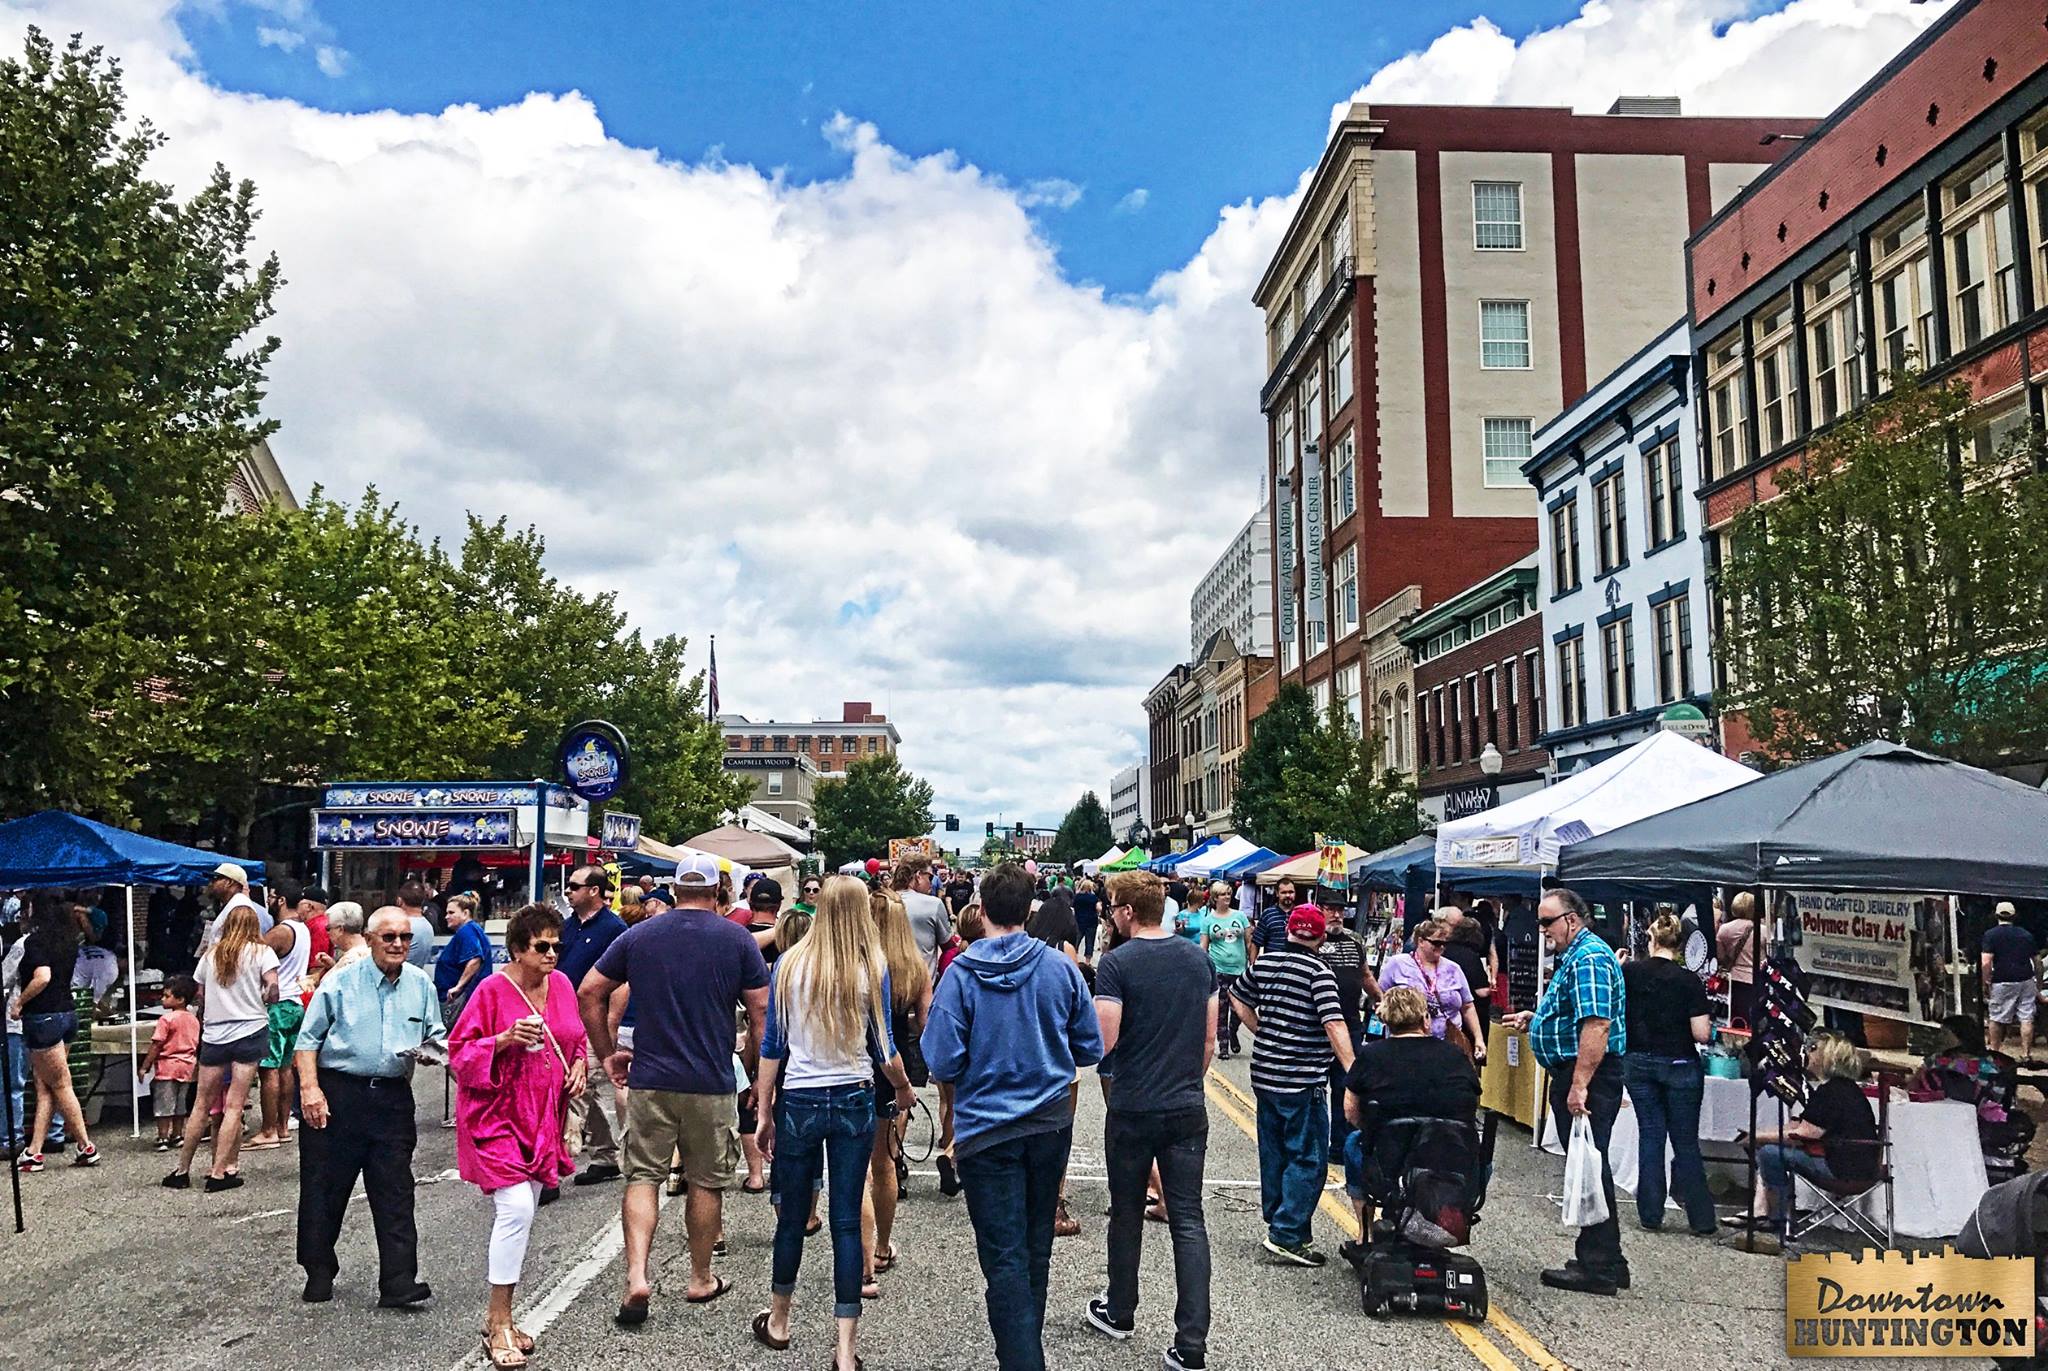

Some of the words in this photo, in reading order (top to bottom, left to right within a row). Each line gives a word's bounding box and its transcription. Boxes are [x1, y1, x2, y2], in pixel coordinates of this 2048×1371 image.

[1307, 476, 1320, 524] CENTER
[1279, 501, 1292, 537] MEDIA
[1280, 541, 1292, 550] &
[1308, 525, 1321, 558] ARTS
[1280, 552, 1292, 579] ARTS
[1310, 559, 1322, 601] VISUAL
[1281, 586, 1294, 636] COLLEGE
[727, 758, 762, 766] CAMPBELL
[369, 791, 415, 803] SNOWIE
[452, 791, 498, 803] SNOWIE
[376, 819, 449, 837] SNOWIE
[1799, 895, 1822, 910] HAND
[1824, 897, 1865, 914] CRAFTED
[1867, 900, 1910, 917] JEWELRY
[1803, 911, 1849, 936] Polymer
[1851, 915, 1881, 942] Clay
[1883, 919, 1906, 942] Art
